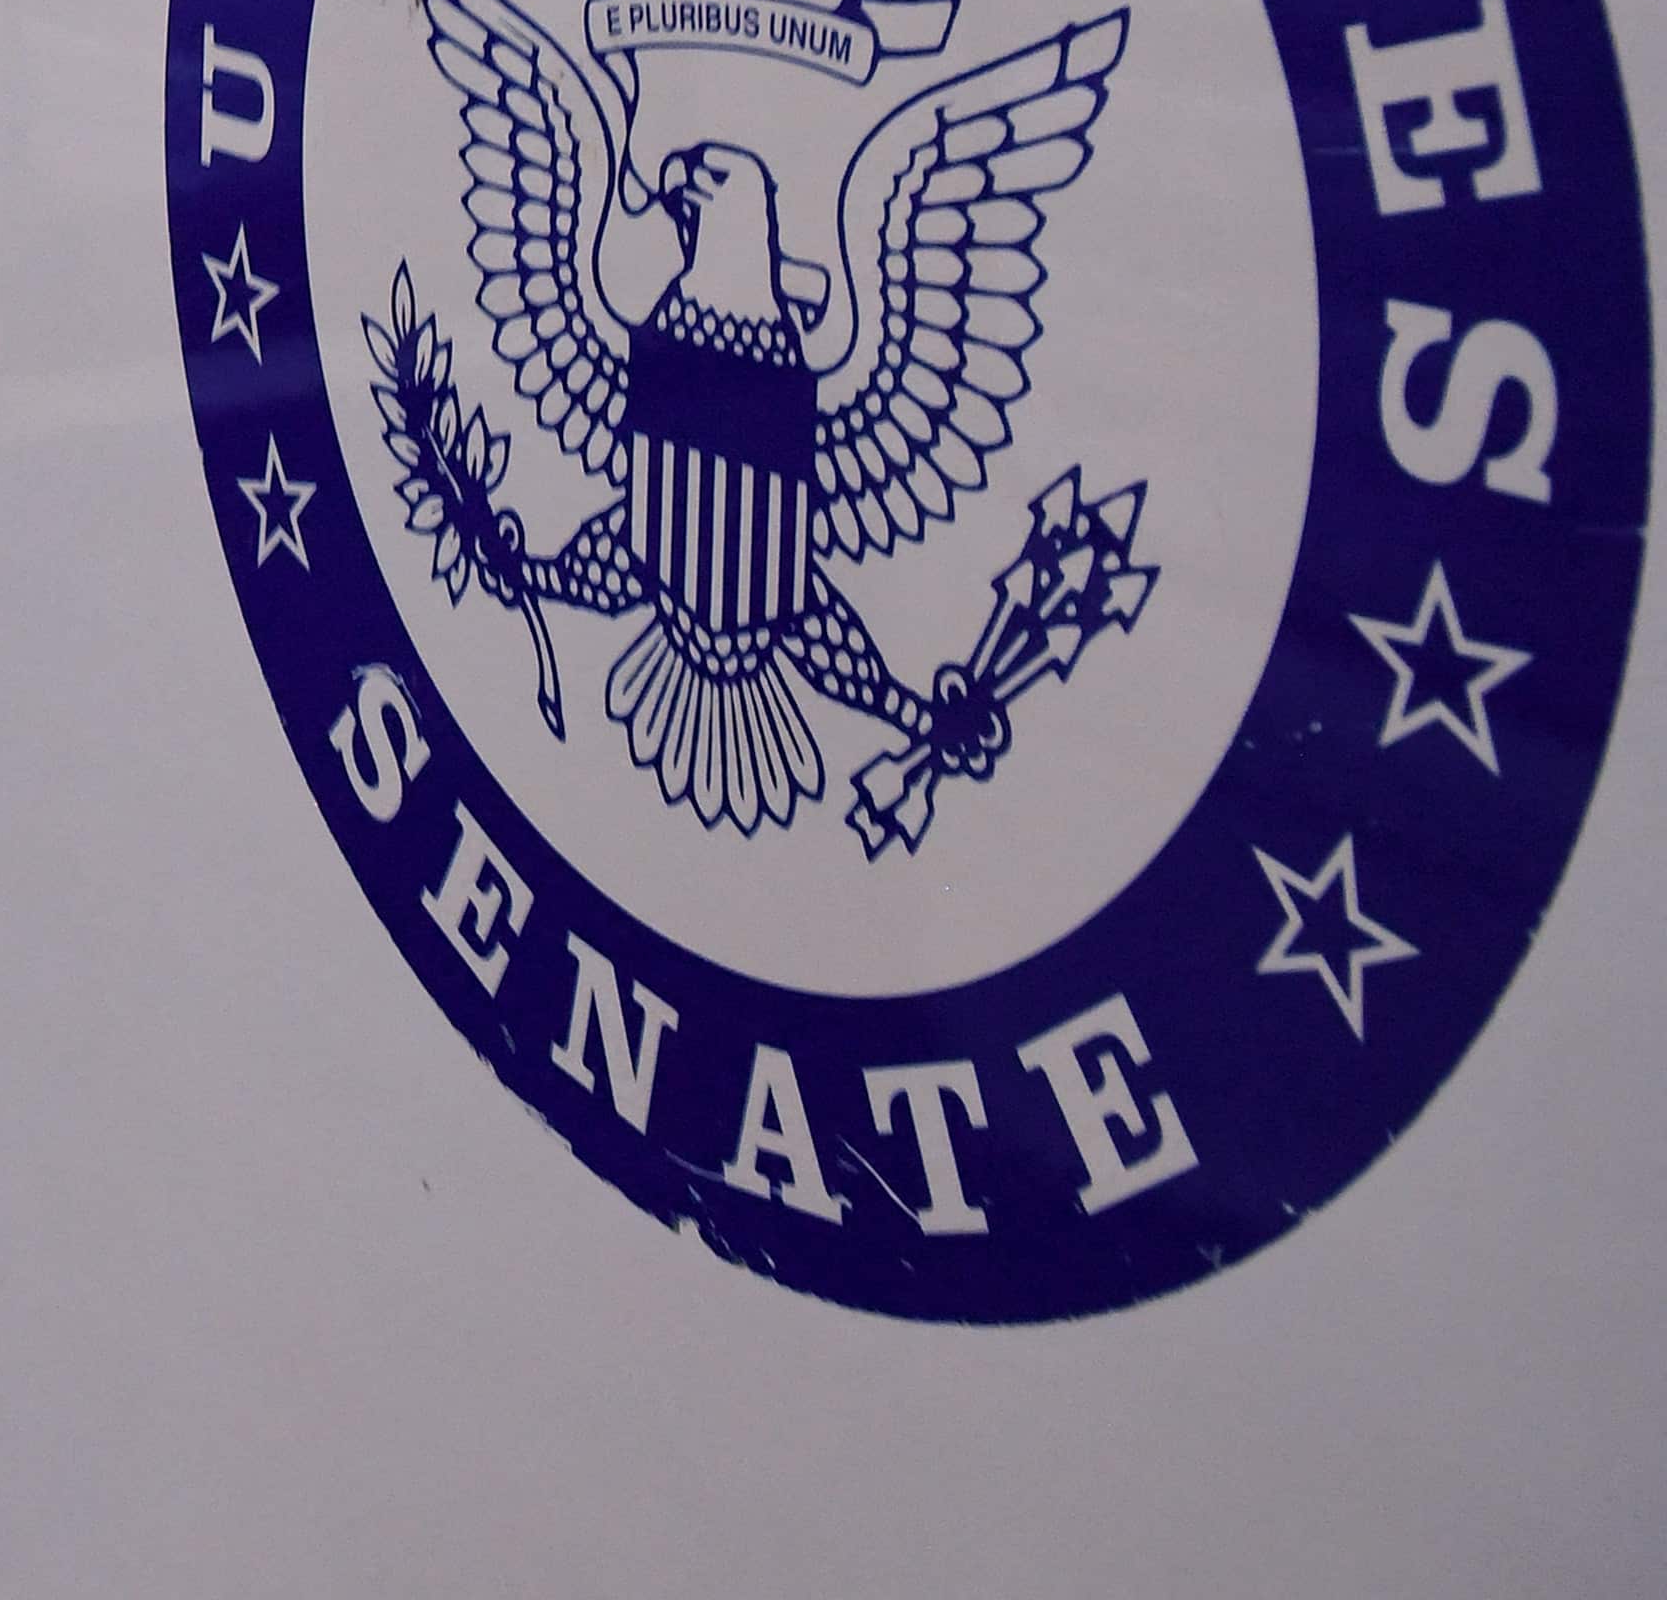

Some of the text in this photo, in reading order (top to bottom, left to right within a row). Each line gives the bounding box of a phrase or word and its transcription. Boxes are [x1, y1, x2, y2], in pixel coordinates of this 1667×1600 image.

[606, 1, 853, 65] E PLURIBUS UNUM
[329, 664, 1199, 1235] SENATE
